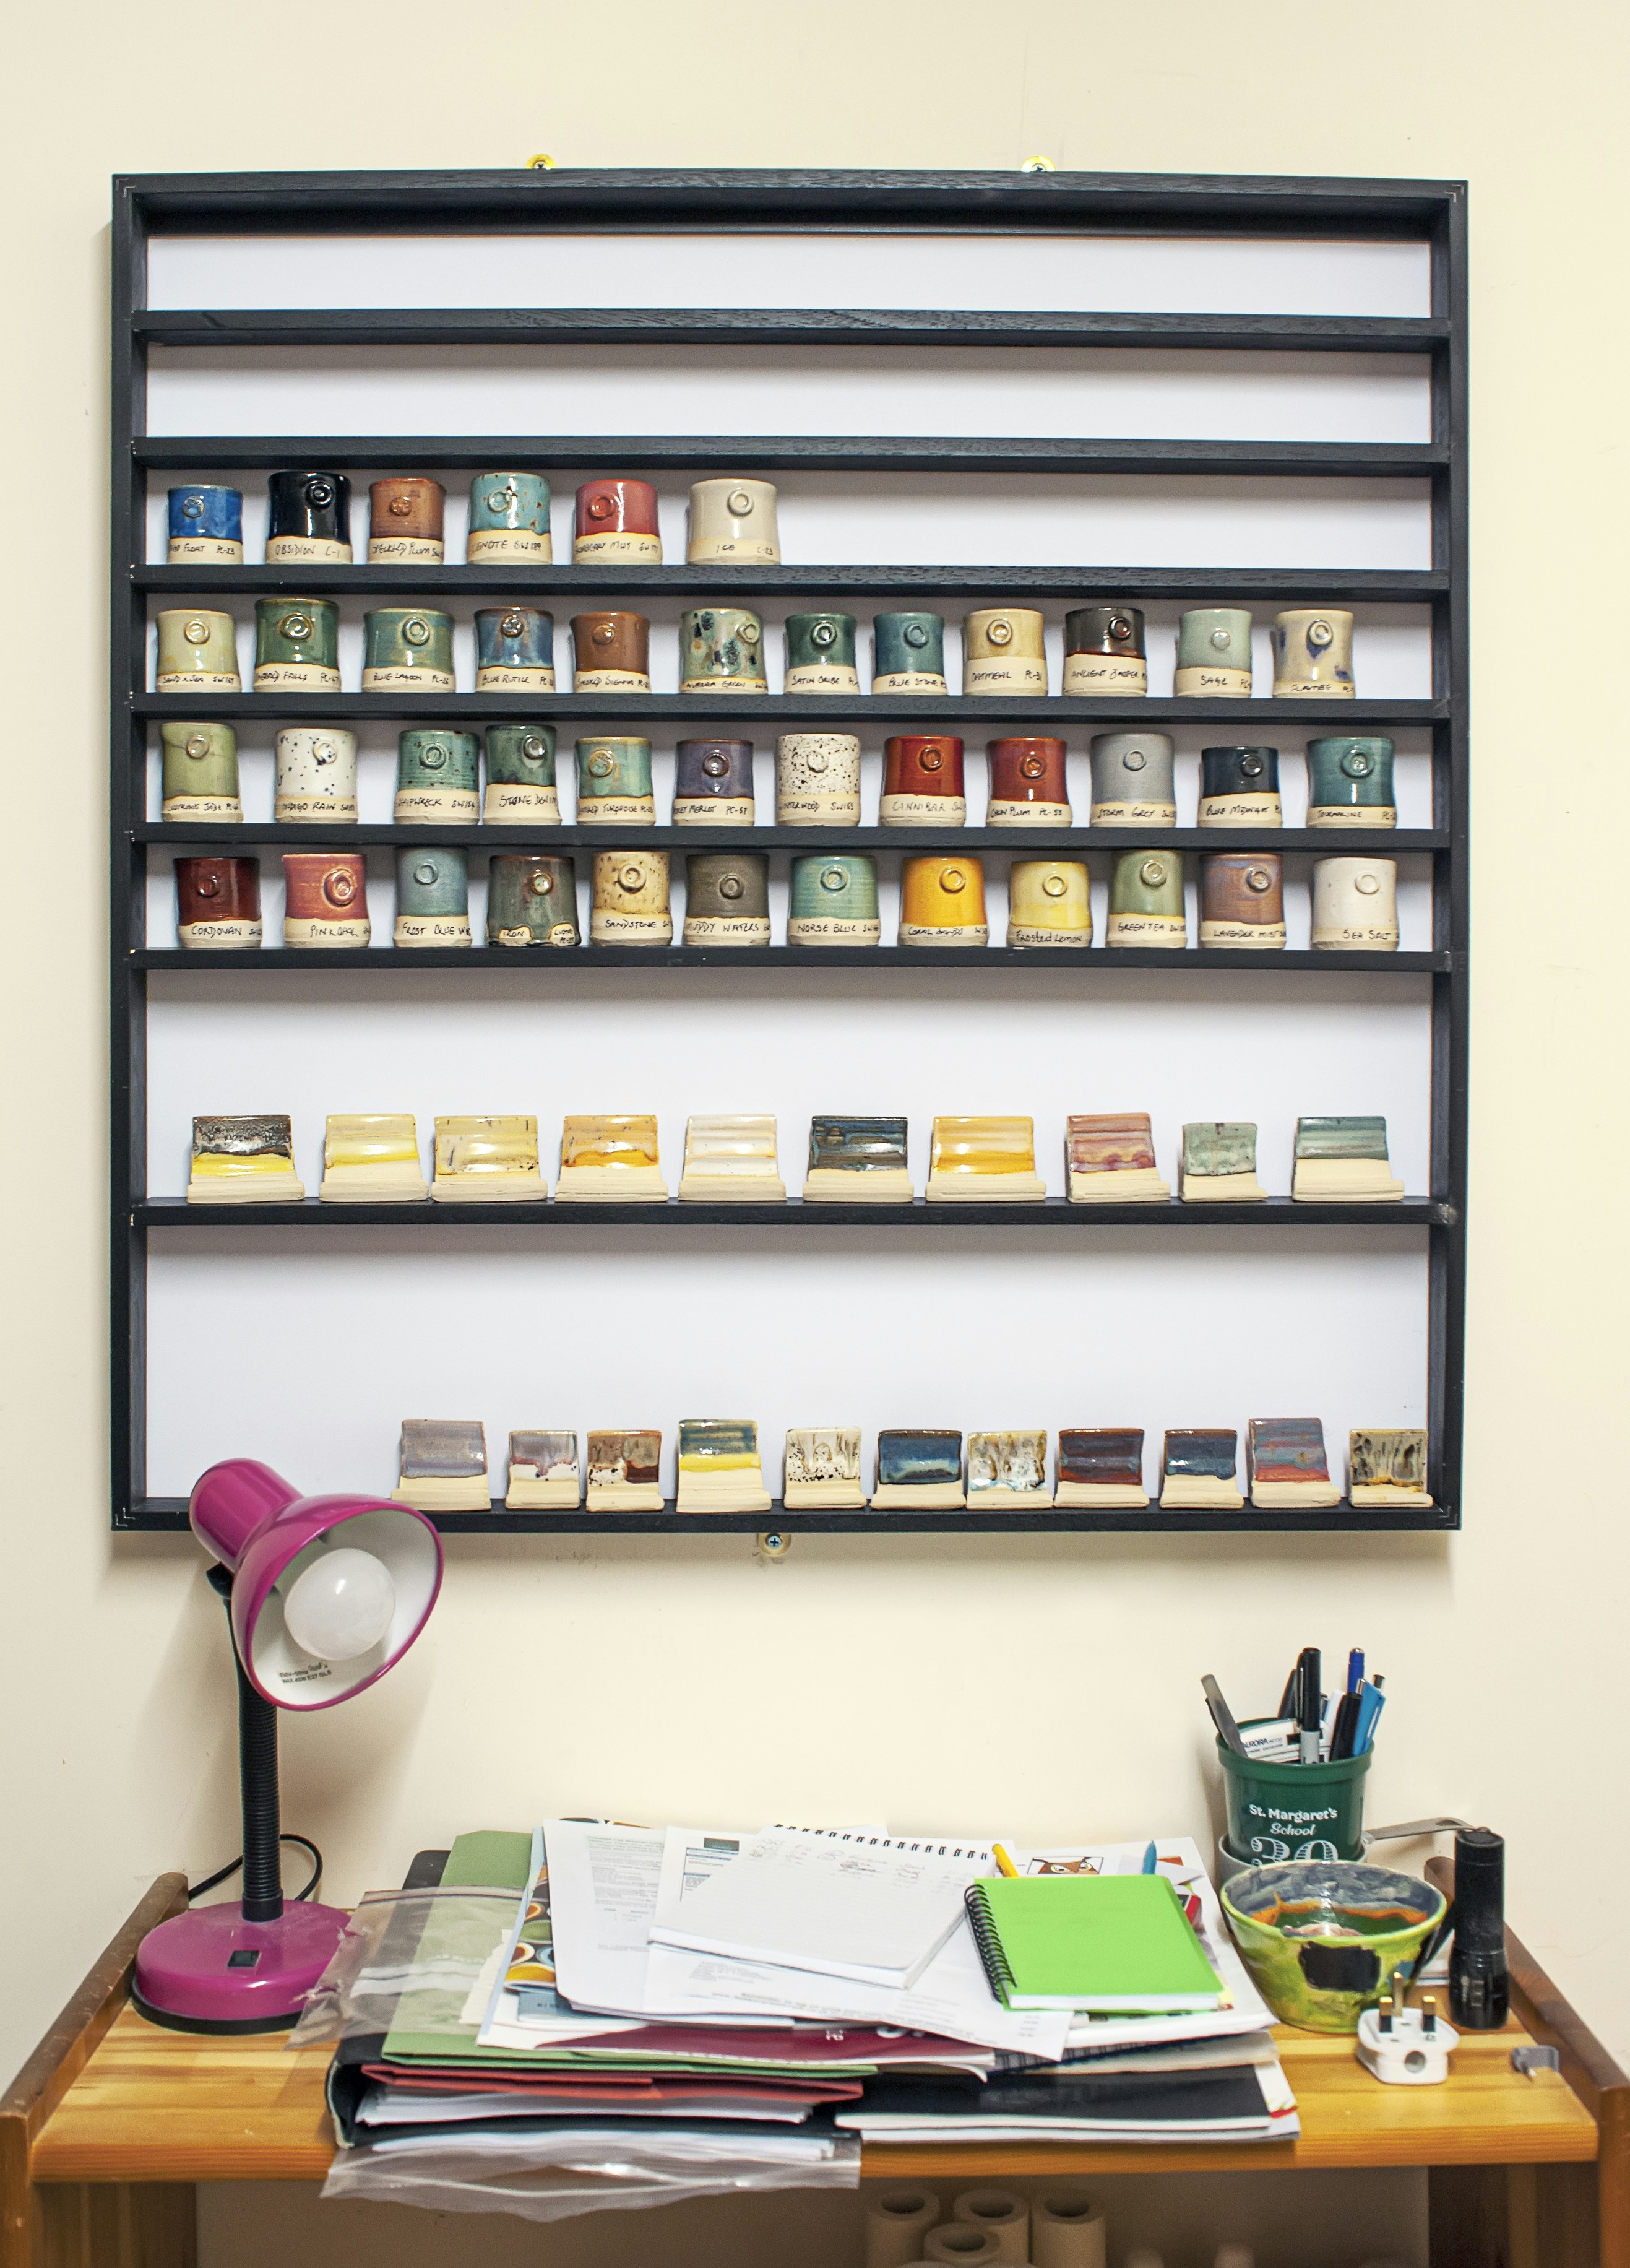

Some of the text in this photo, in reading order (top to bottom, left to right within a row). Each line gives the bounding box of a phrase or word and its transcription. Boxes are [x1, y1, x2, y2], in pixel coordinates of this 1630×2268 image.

[889, 677, 910, 688] BLUE
[605, 919, 657, 930] SANDSTONE
[796, 924, 829, 933] NORSE
[1249, 1803, 1339, 1823] St. Margaret's
[1270, 1822, 1316, 1836] School
